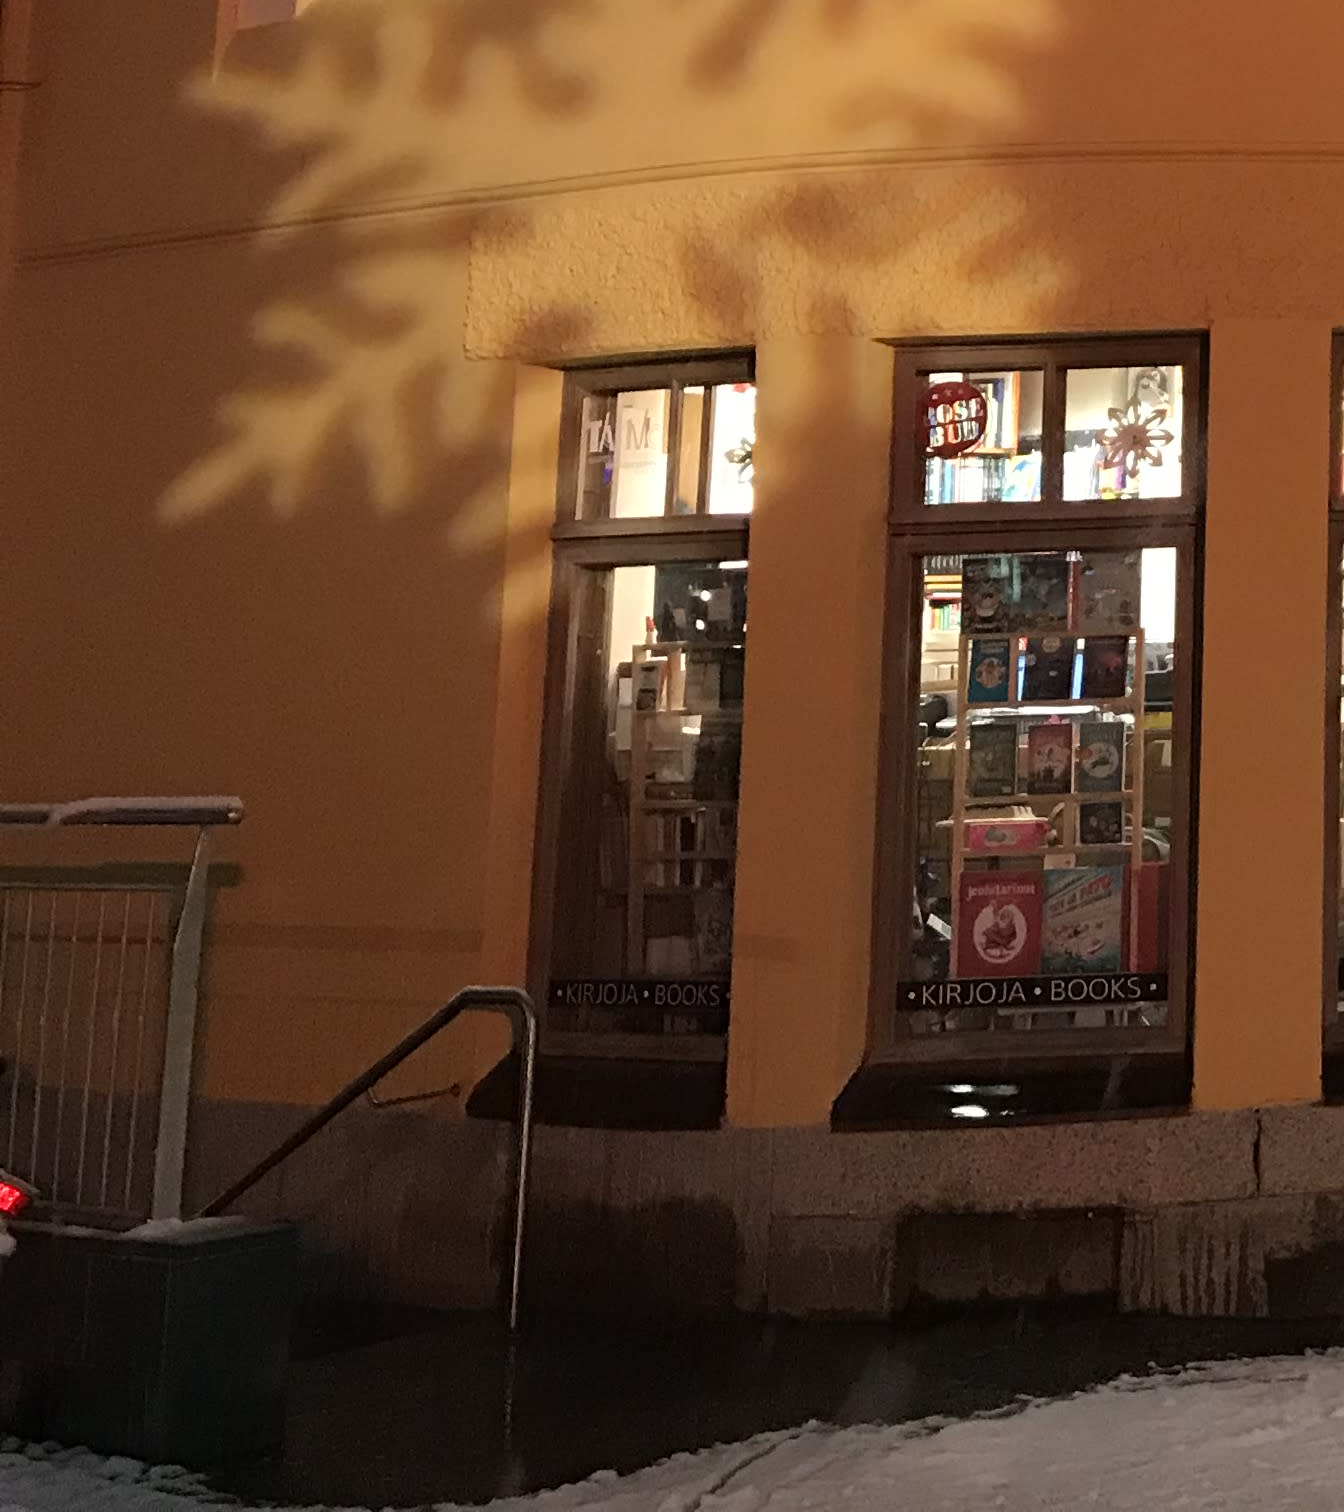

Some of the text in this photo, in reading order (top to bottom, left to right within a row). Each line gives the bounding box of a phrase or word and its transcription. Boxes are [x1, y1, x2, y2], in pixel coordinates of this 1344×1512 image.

[565, 983, 721, 1006] KIRJOJA BOOKS
[921, 976, 1142, 1007] KIRJOJA BOOKS
